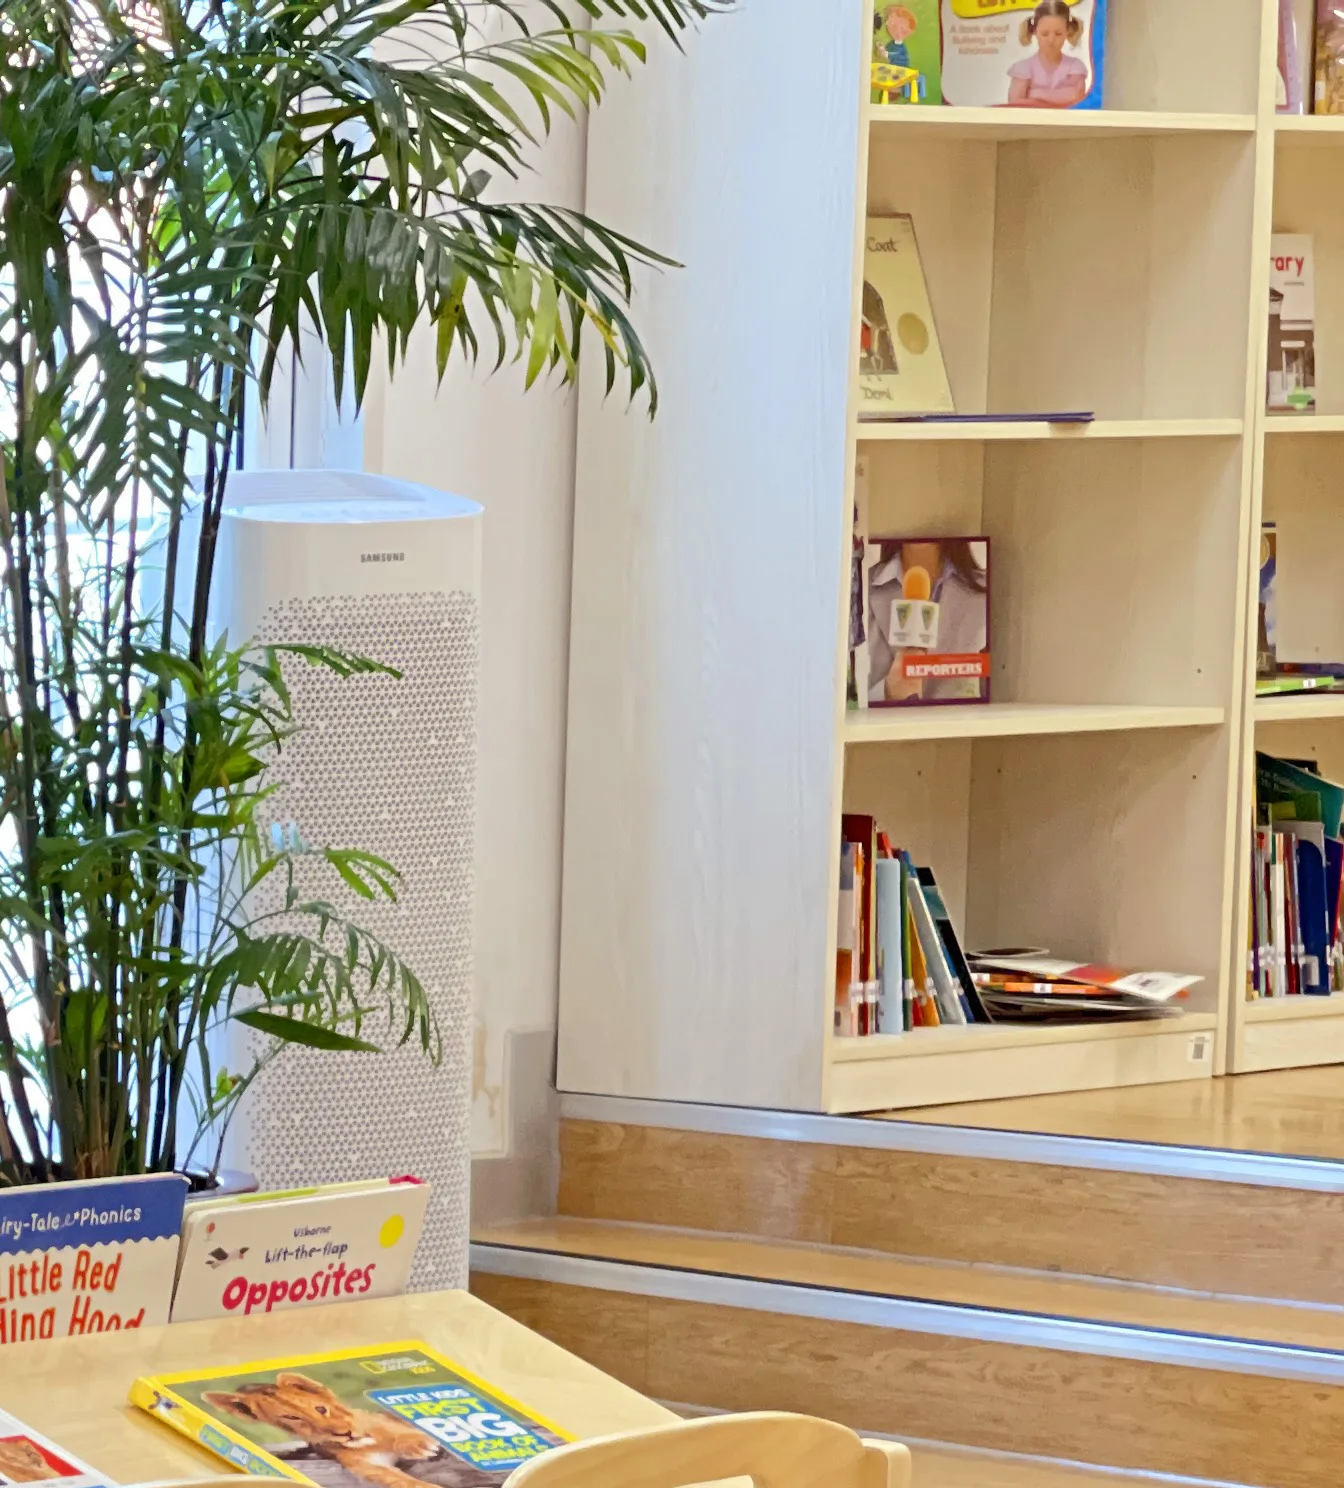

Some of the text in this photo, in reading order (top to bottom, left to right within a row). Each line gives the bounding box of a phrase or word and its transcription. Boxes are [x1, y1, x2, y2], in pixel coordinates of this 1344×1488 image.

[866, 236, 900, 253] Coat
[1270, 256, 1305, 277] ary
[360, 552, 405, 563] SAMSUNG
[905, 662, 983, 677] REPORTERS
[80, 1204, 142, 1227] Phonics
[293, 1225, 332, 1238] Usborne
[265, 1241, 349, 1264] Lift-the-flap
[72, 1250, 123, 1293] Red
[222, 1262, 376, 1315] Opposites
[391, 1397, 487, 1420] FIRST
[413, 1412, 529, 1443] BIG
